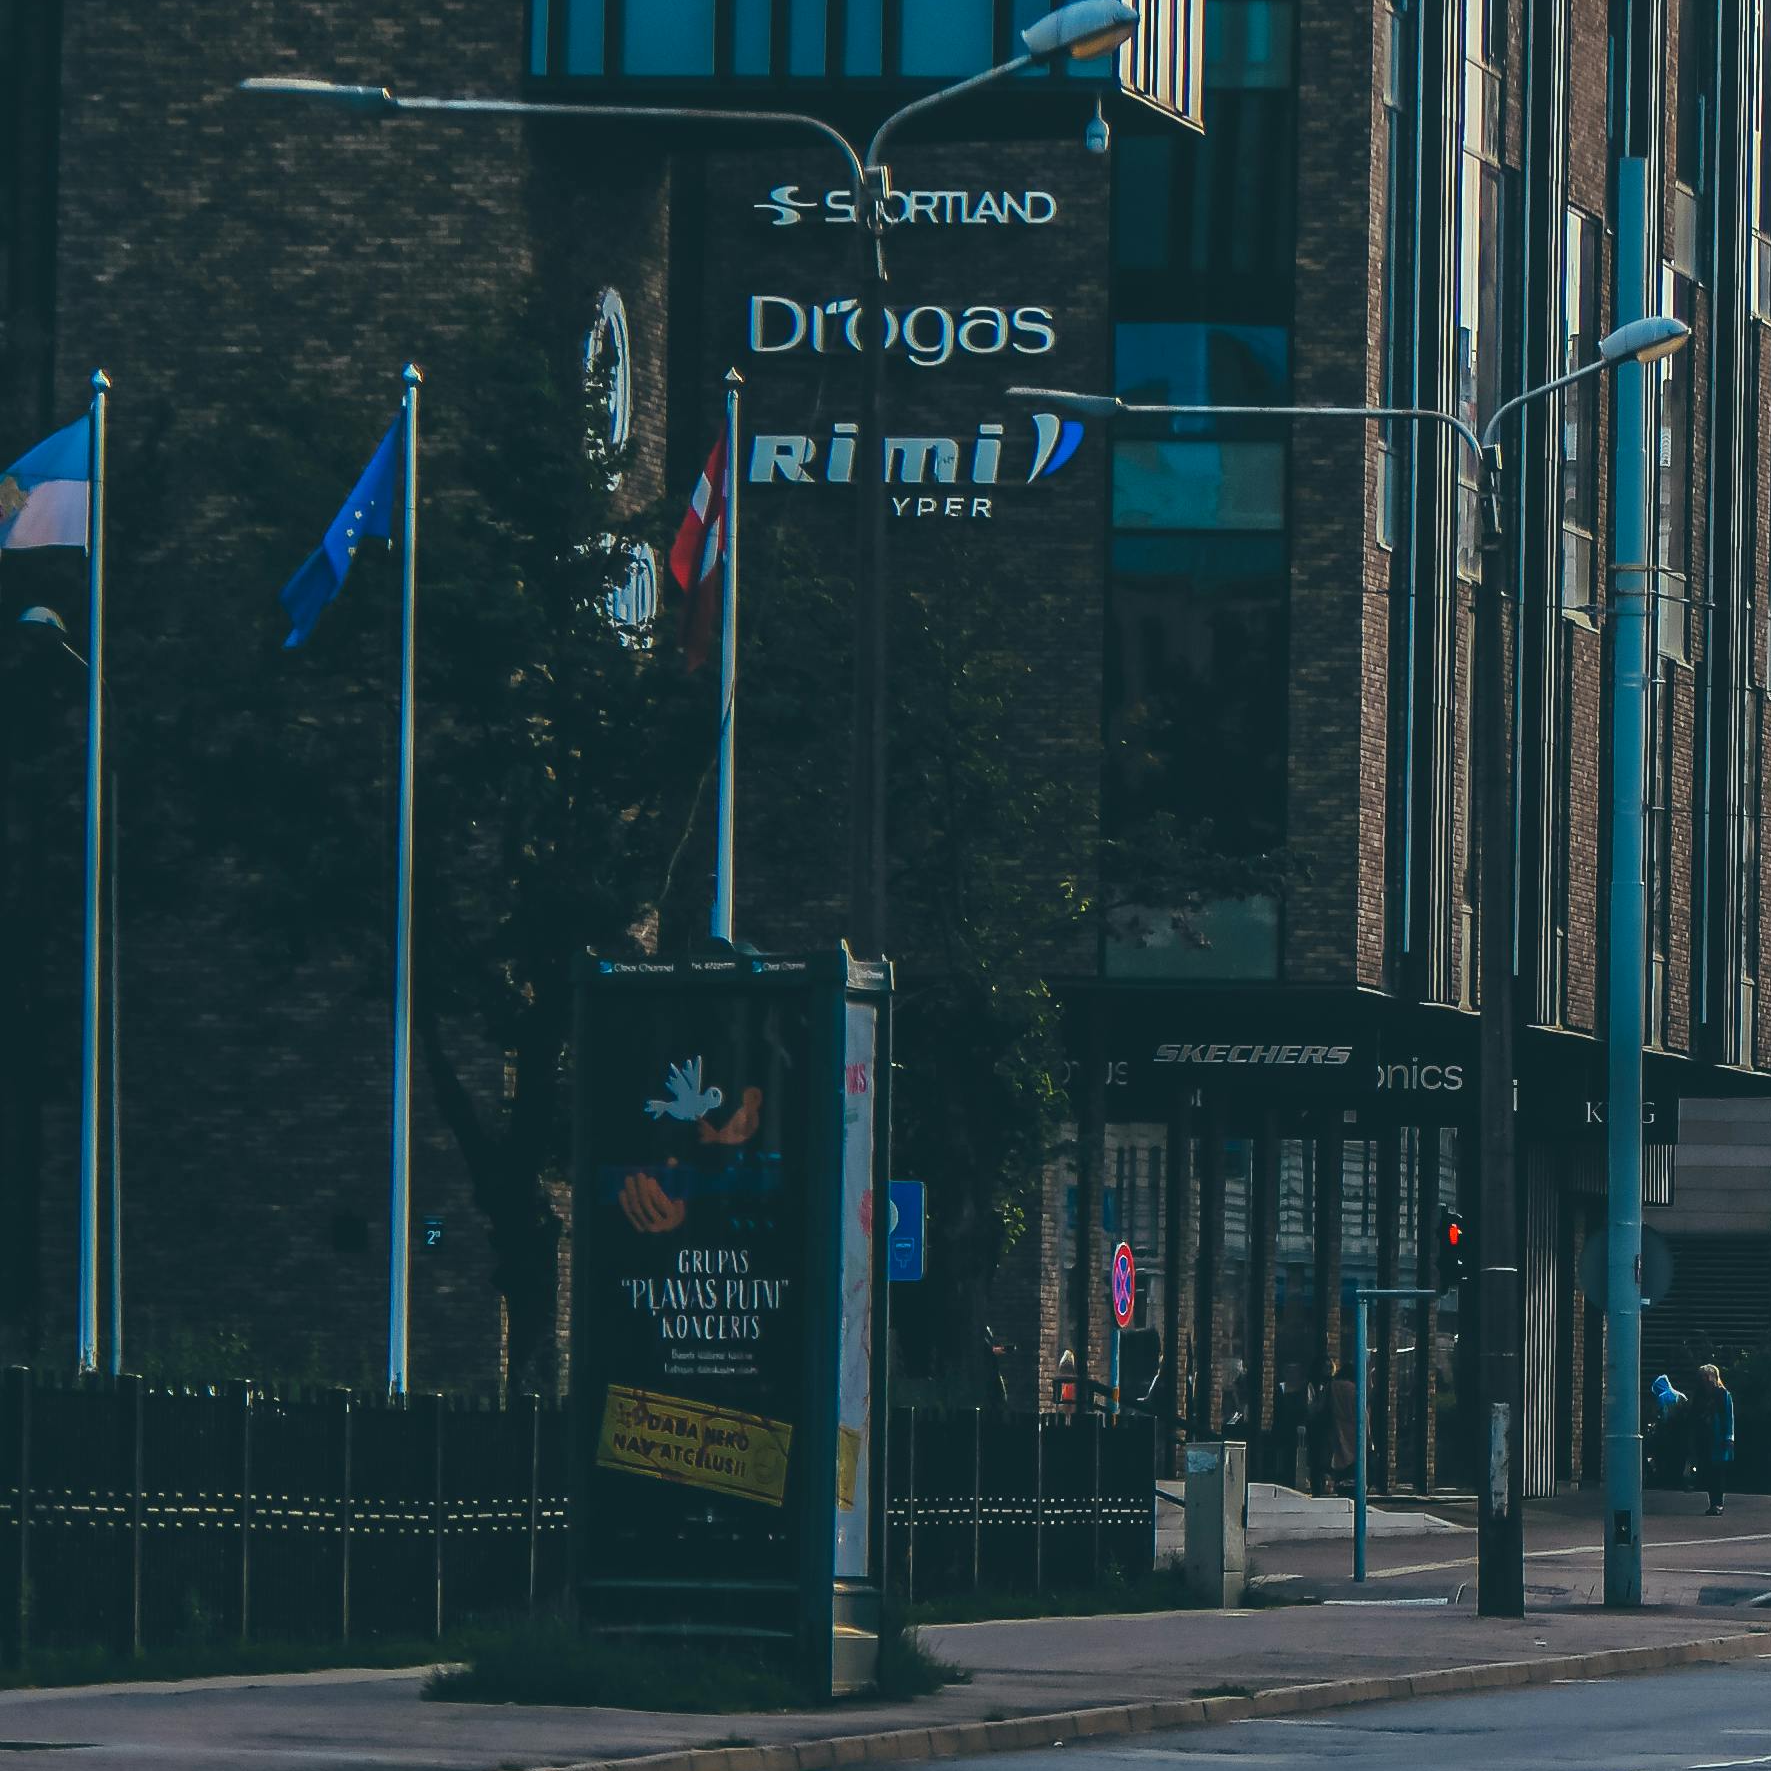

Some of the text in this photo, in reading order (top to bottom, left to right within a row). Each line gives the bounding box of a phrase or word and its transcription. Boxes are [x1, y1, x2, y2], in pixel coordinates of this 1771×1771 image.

[824, 190, 1056, 225] SORTLAND
[751, 295, 1056, 366] Drogas
[891, 496, 992, 518] YPER
[1153, 1044, 1353, 1065] SKECHERS
[678, 1248, 751, 1274] GRUPAS
[662, 1314, 761, 1340] KONCERTS
